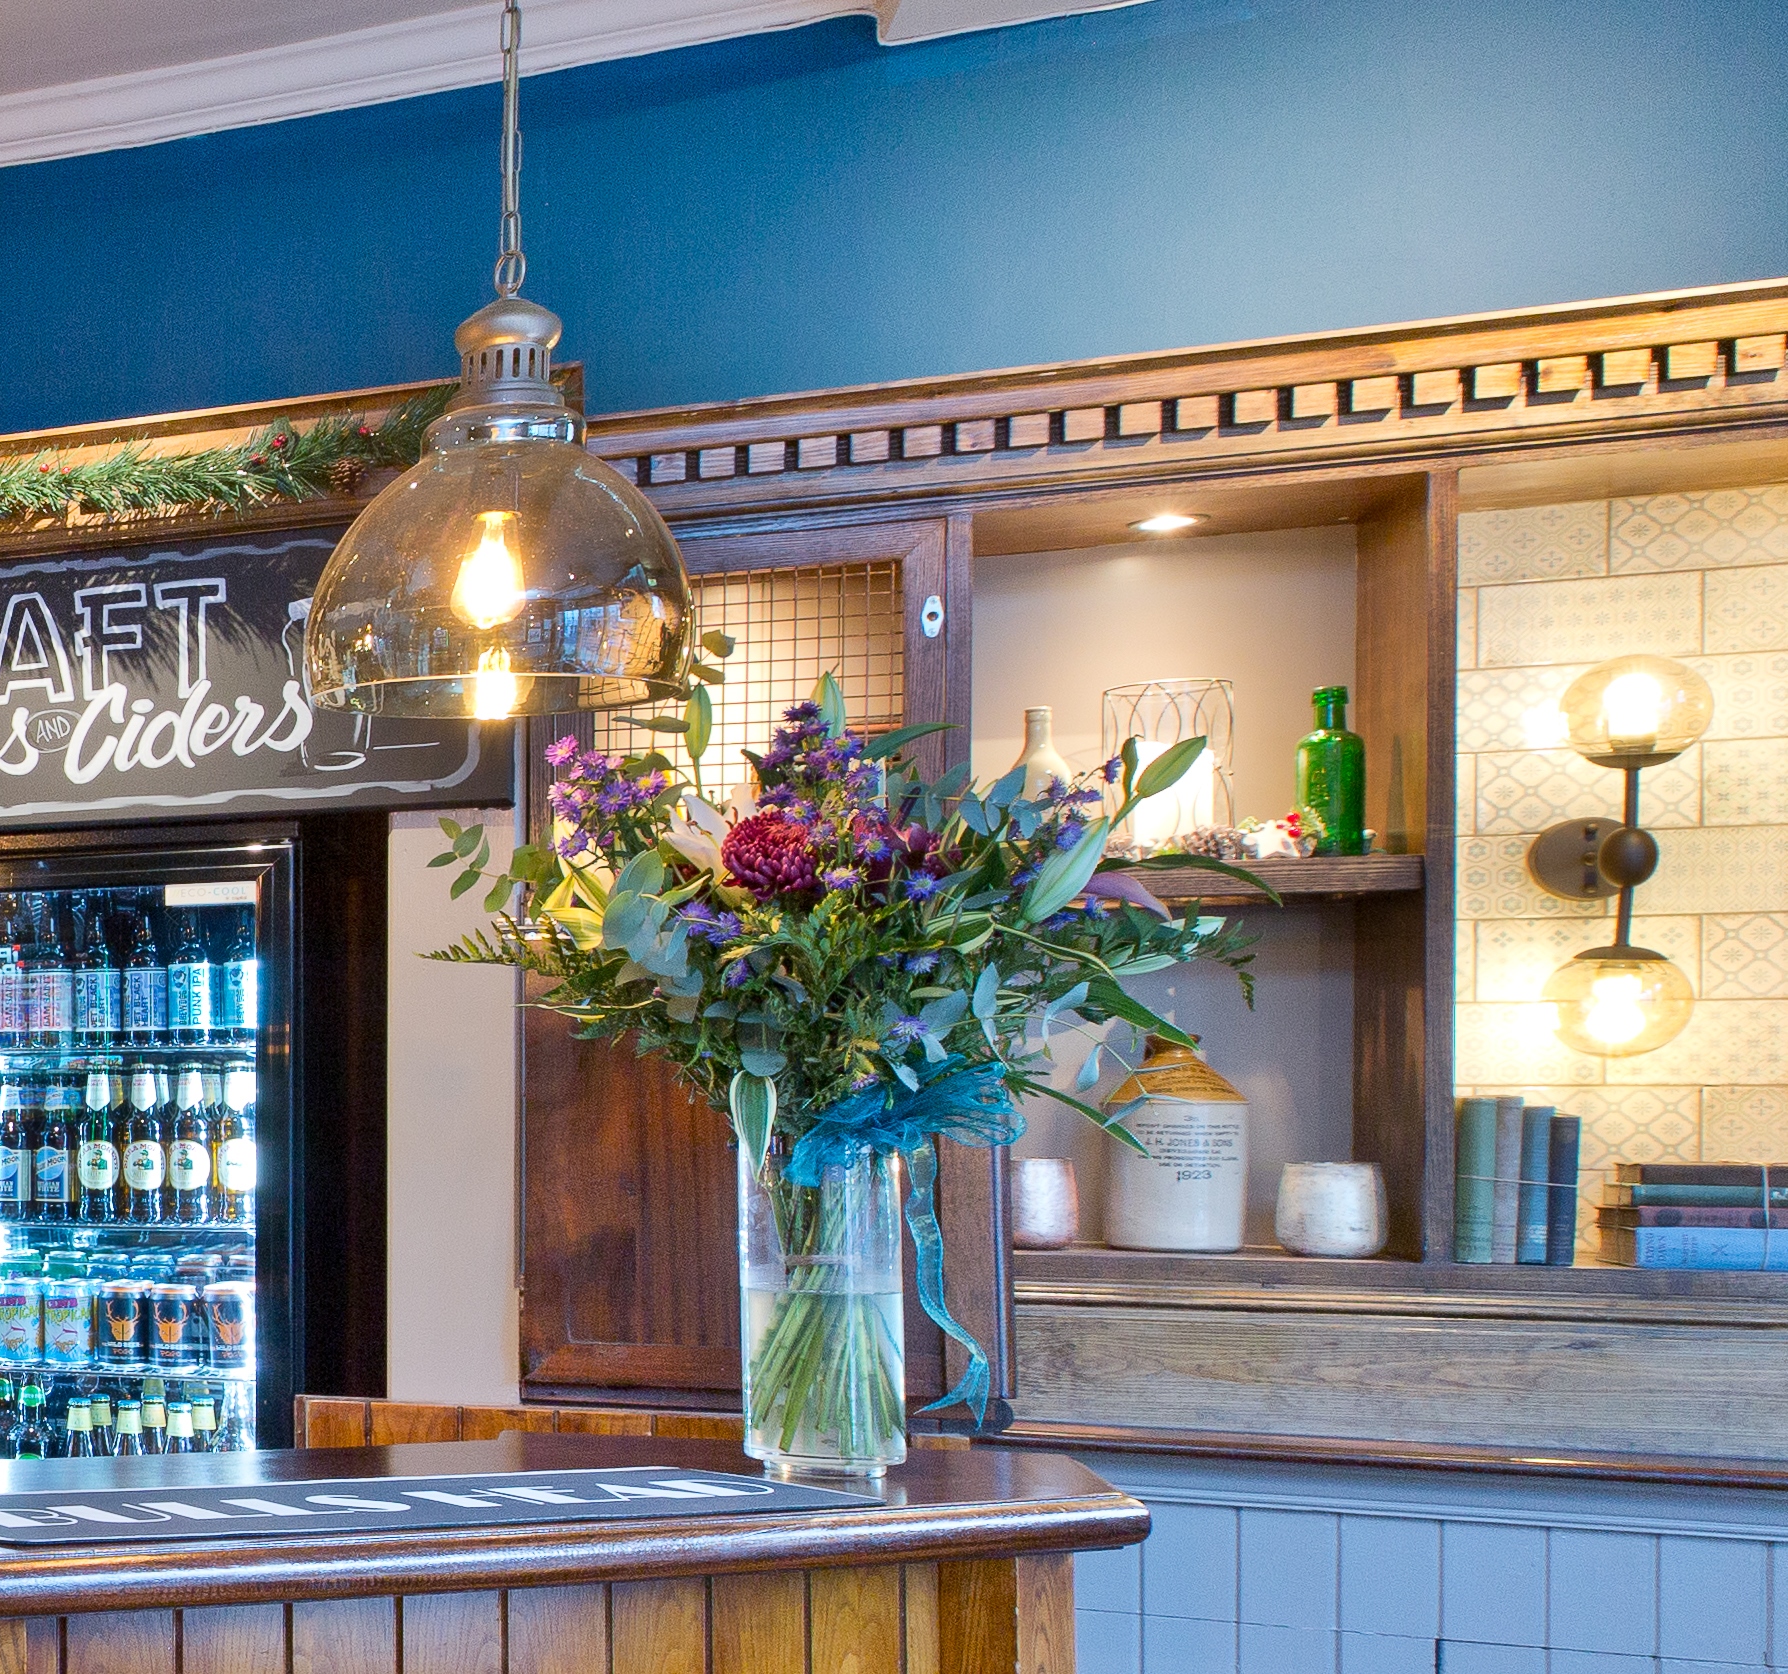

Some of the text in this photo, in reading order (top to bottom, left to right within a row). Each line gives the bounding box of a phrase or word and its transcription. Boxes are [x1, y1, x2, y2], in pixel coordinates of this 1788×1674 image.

[35, 714, 72, 743] AND
[62, 679, 314, 784] Ciders
[89, 977, 98, 1008] BLACK
[133, 977, 141, 1007] BLACK
[192, 967, 202, 1026] PUNK IPA
[1167, 1138, 1200, 1147] JONES
[1203, 1139, 1210, 1147] &
[1211, 1138, 1233, 1147] SONS
[47, 1155, 67, 1166] MOON
[1176, 1169, 1212, 1182] 1923
[1657, 1235, 1667, 1263] DAWN
[400, 1479, 775, 1508] HEAD
